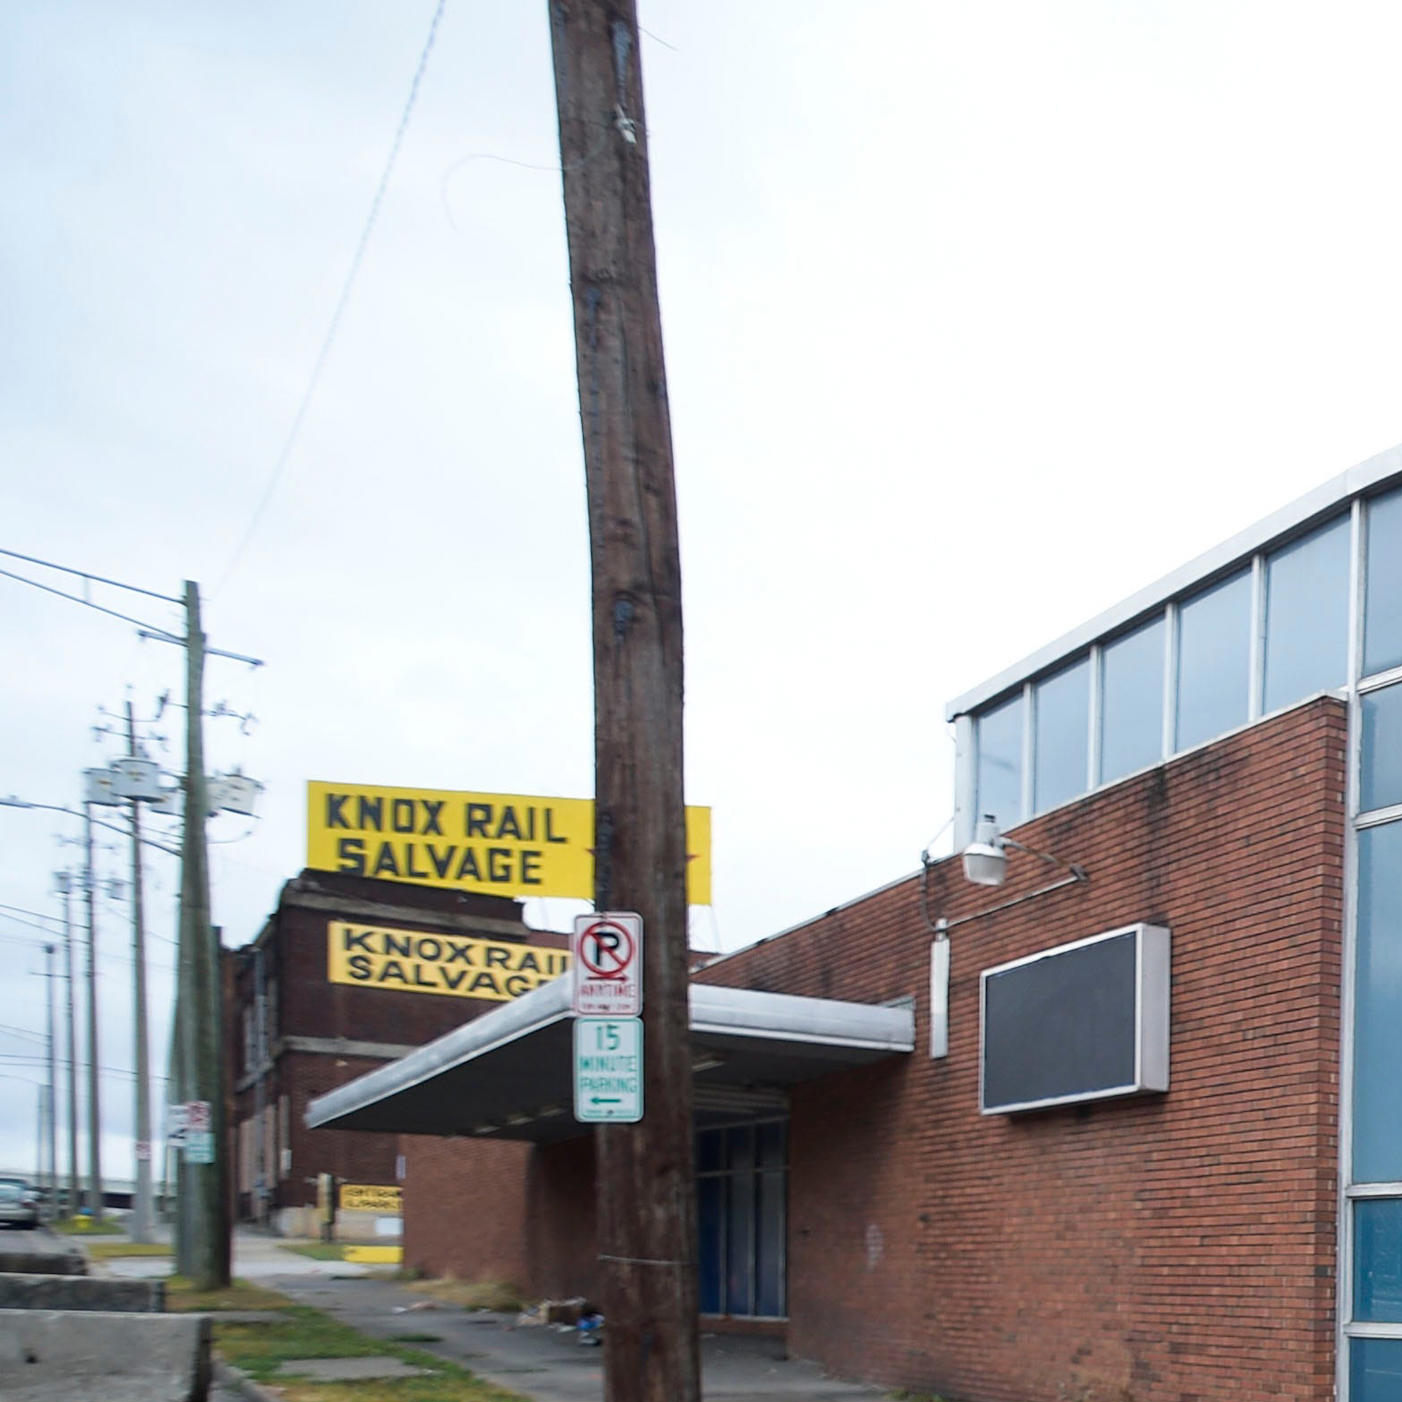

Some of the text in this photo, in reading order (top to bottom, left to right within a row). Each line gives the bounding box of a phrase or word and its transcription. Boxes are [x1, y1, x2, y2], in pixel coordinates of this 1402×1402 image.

[325, 793, 567, 843] KNOX RAIL
[337, 838, 543, 885] SALVAGE
[343, 929, 473, 965] KNOX
[348, 955, 552, 998] SALVAG
[596, 1024, 620, 1050] 15
[579, 1055, 637, 1072] MINUTE
[579, 1076, 638, 1093] PARKING
